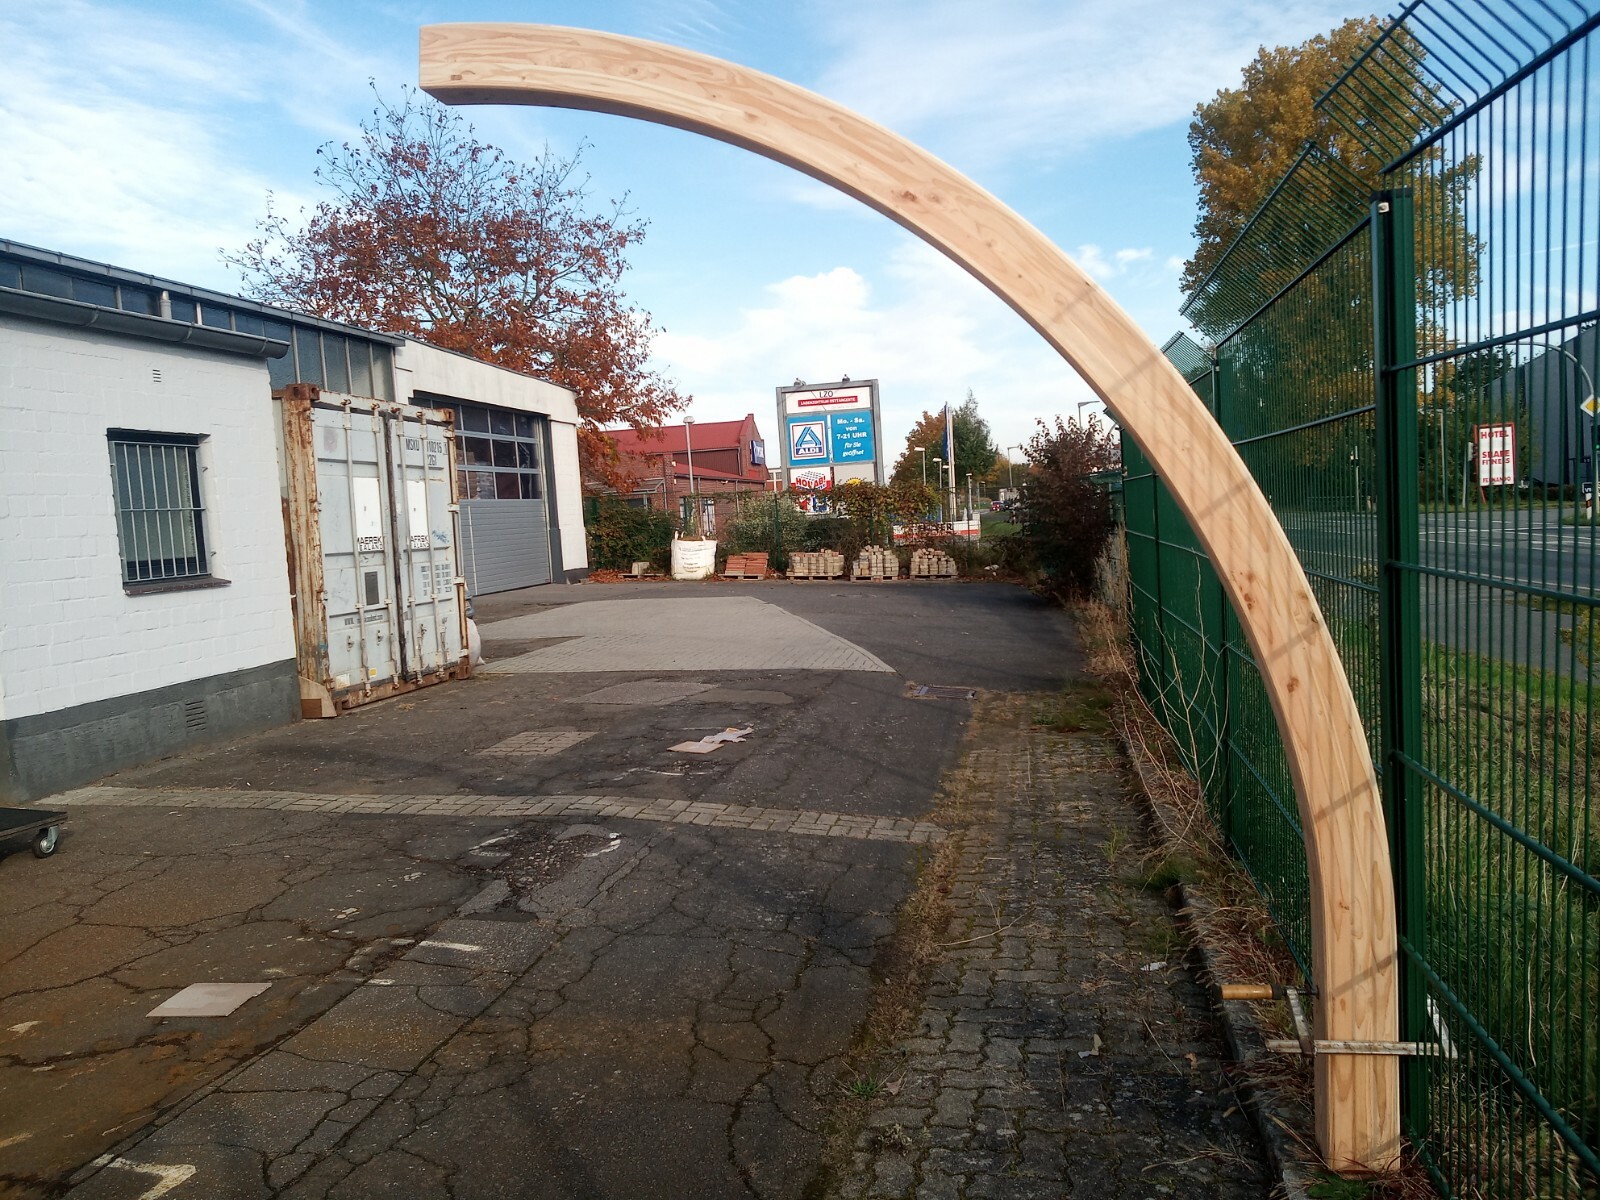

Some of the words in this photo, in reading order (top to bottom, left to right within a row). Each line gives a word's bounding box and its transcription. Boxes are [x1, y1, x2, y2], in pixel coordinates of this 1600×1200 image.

[852, 431, 867, 439] UHR
[1480, 430, 1509, 439] HOTEL
[411, 535, 429, 543] AERSK
[359, 543, 383, 552] EALAND
